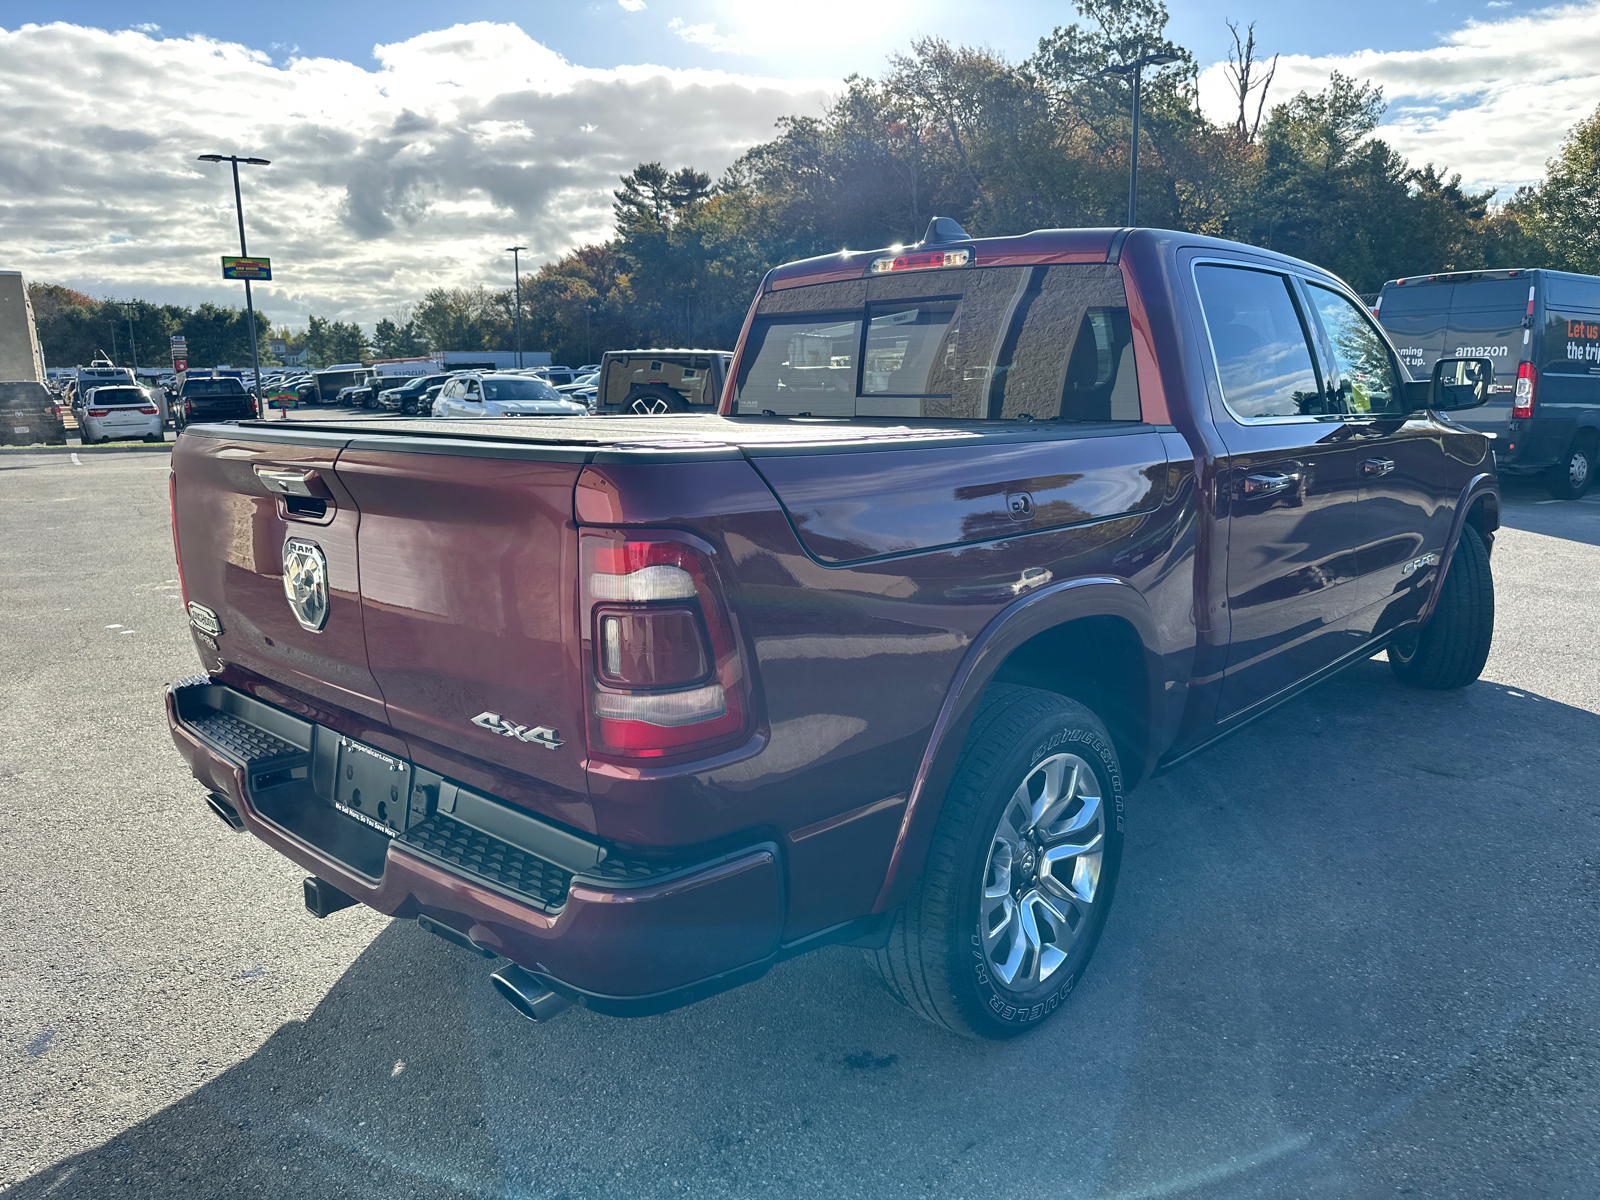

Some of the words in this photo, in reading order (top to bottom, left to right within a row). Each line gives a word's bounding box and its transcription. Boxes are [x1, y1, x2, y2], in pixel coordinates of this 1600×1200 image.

[1567, 320, 1585, 338] Let
[1586, 325, 1599, 339] us
[1455, 346, 1508, 357] amazon
[1566, 341, 1584, 360] the
[289, 542, 314, 555] RAM
[1029, 728, 1124, 833] BRIDGESTONE
[989, 974, 1074, 1022] DUELER
